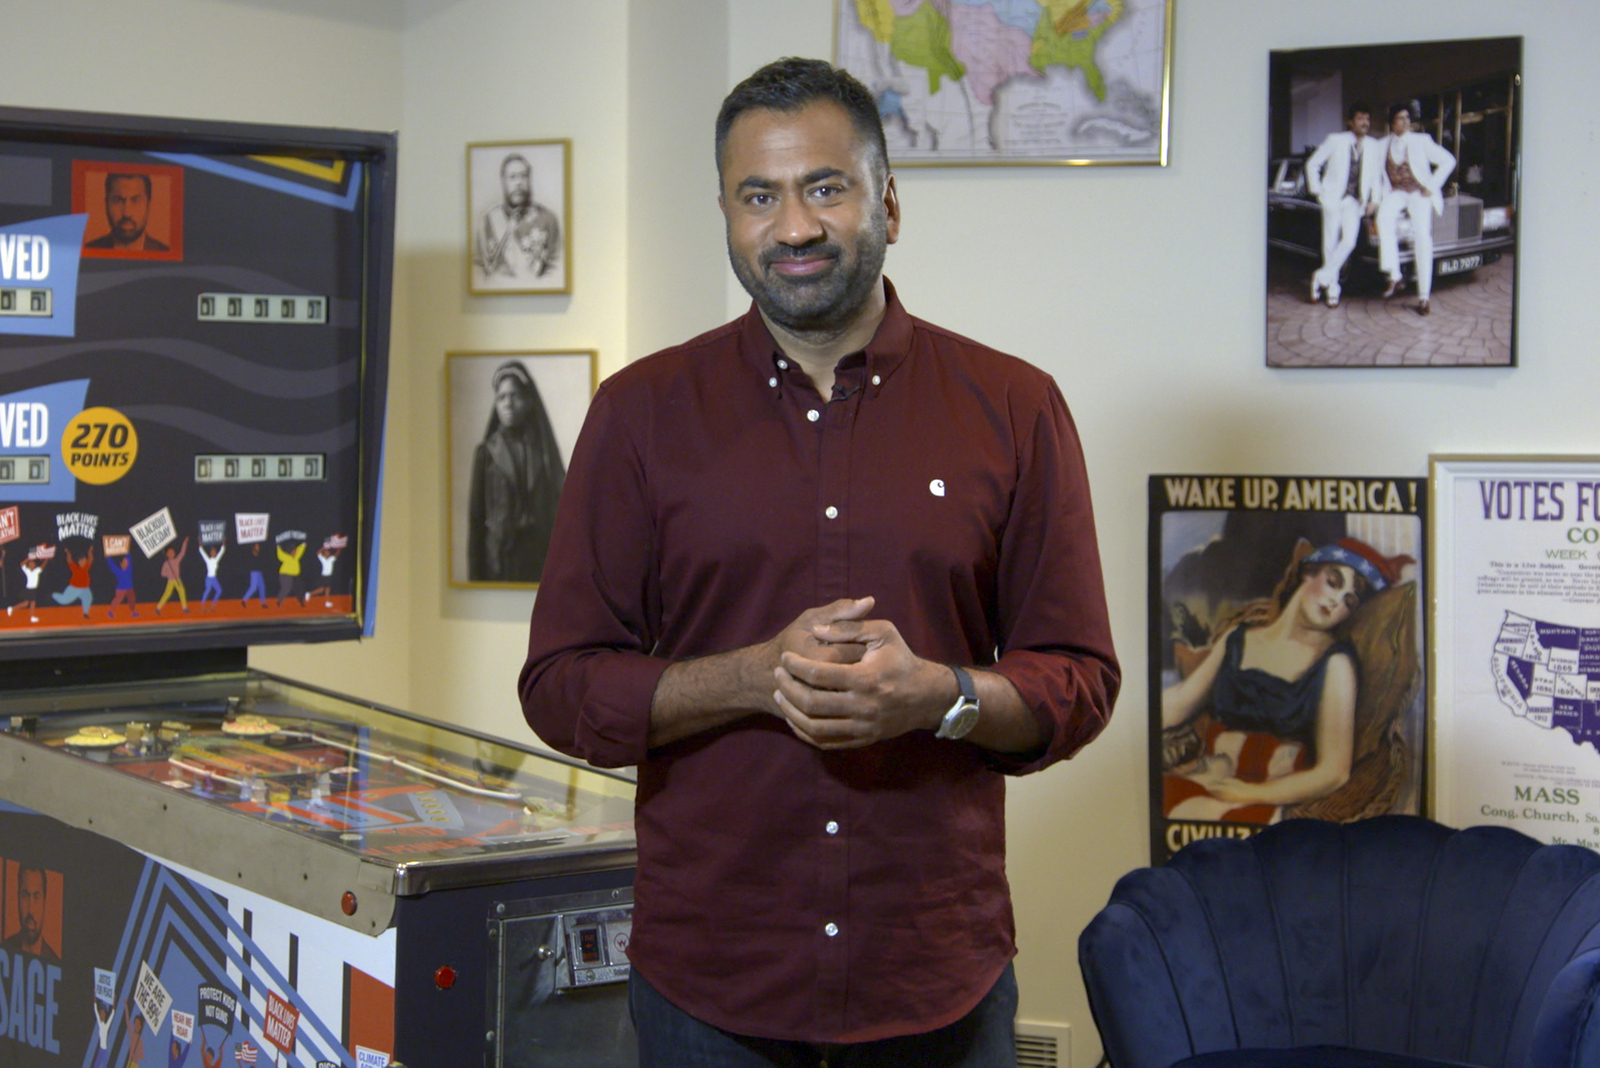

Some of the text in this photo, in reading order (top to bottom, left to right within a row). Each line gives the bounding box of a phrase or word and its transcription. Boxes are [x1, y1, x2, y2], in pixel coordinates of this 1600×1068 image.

[0, 233, 50, 280] VED
[0, 402, 48, 448] VED
[71, 423, 129, 449] 270
[71, 452, 129, 467] POINTS
[1163, 478, 1236, 507] WAKE
[1479, 481, 1564, 521] VOTES
[56, 512, 98, 528] BLACK LIVES
[58, 523, 95, 541] MATTER
[135, 512, 167, 541] BLACKOUT
[240, 527, 264, 539] MATTER
[143, 525, 172, 552] TUESDAY
[1545, 549, 1588, 560] WEEK
[1515, 785, 1580, 805] MASS
[1481, 804, 1519, 819] Cong.
[1522, 807, 1579, 824] Church,
[0, 948, 62, 1055] SAGE
[135, 981, 150, 1009] THE
[143, 969, 166, 1008] WE ARE
[200, 986, 223, 1002] PROTECT
[205, 1004, 215, 1018] NOT
[268, 994, 296, 1030] BLACK LIVES
[267, 1014, 292, 1049] MATTER
[358, 1051, 386, 1068] CLIMATE
